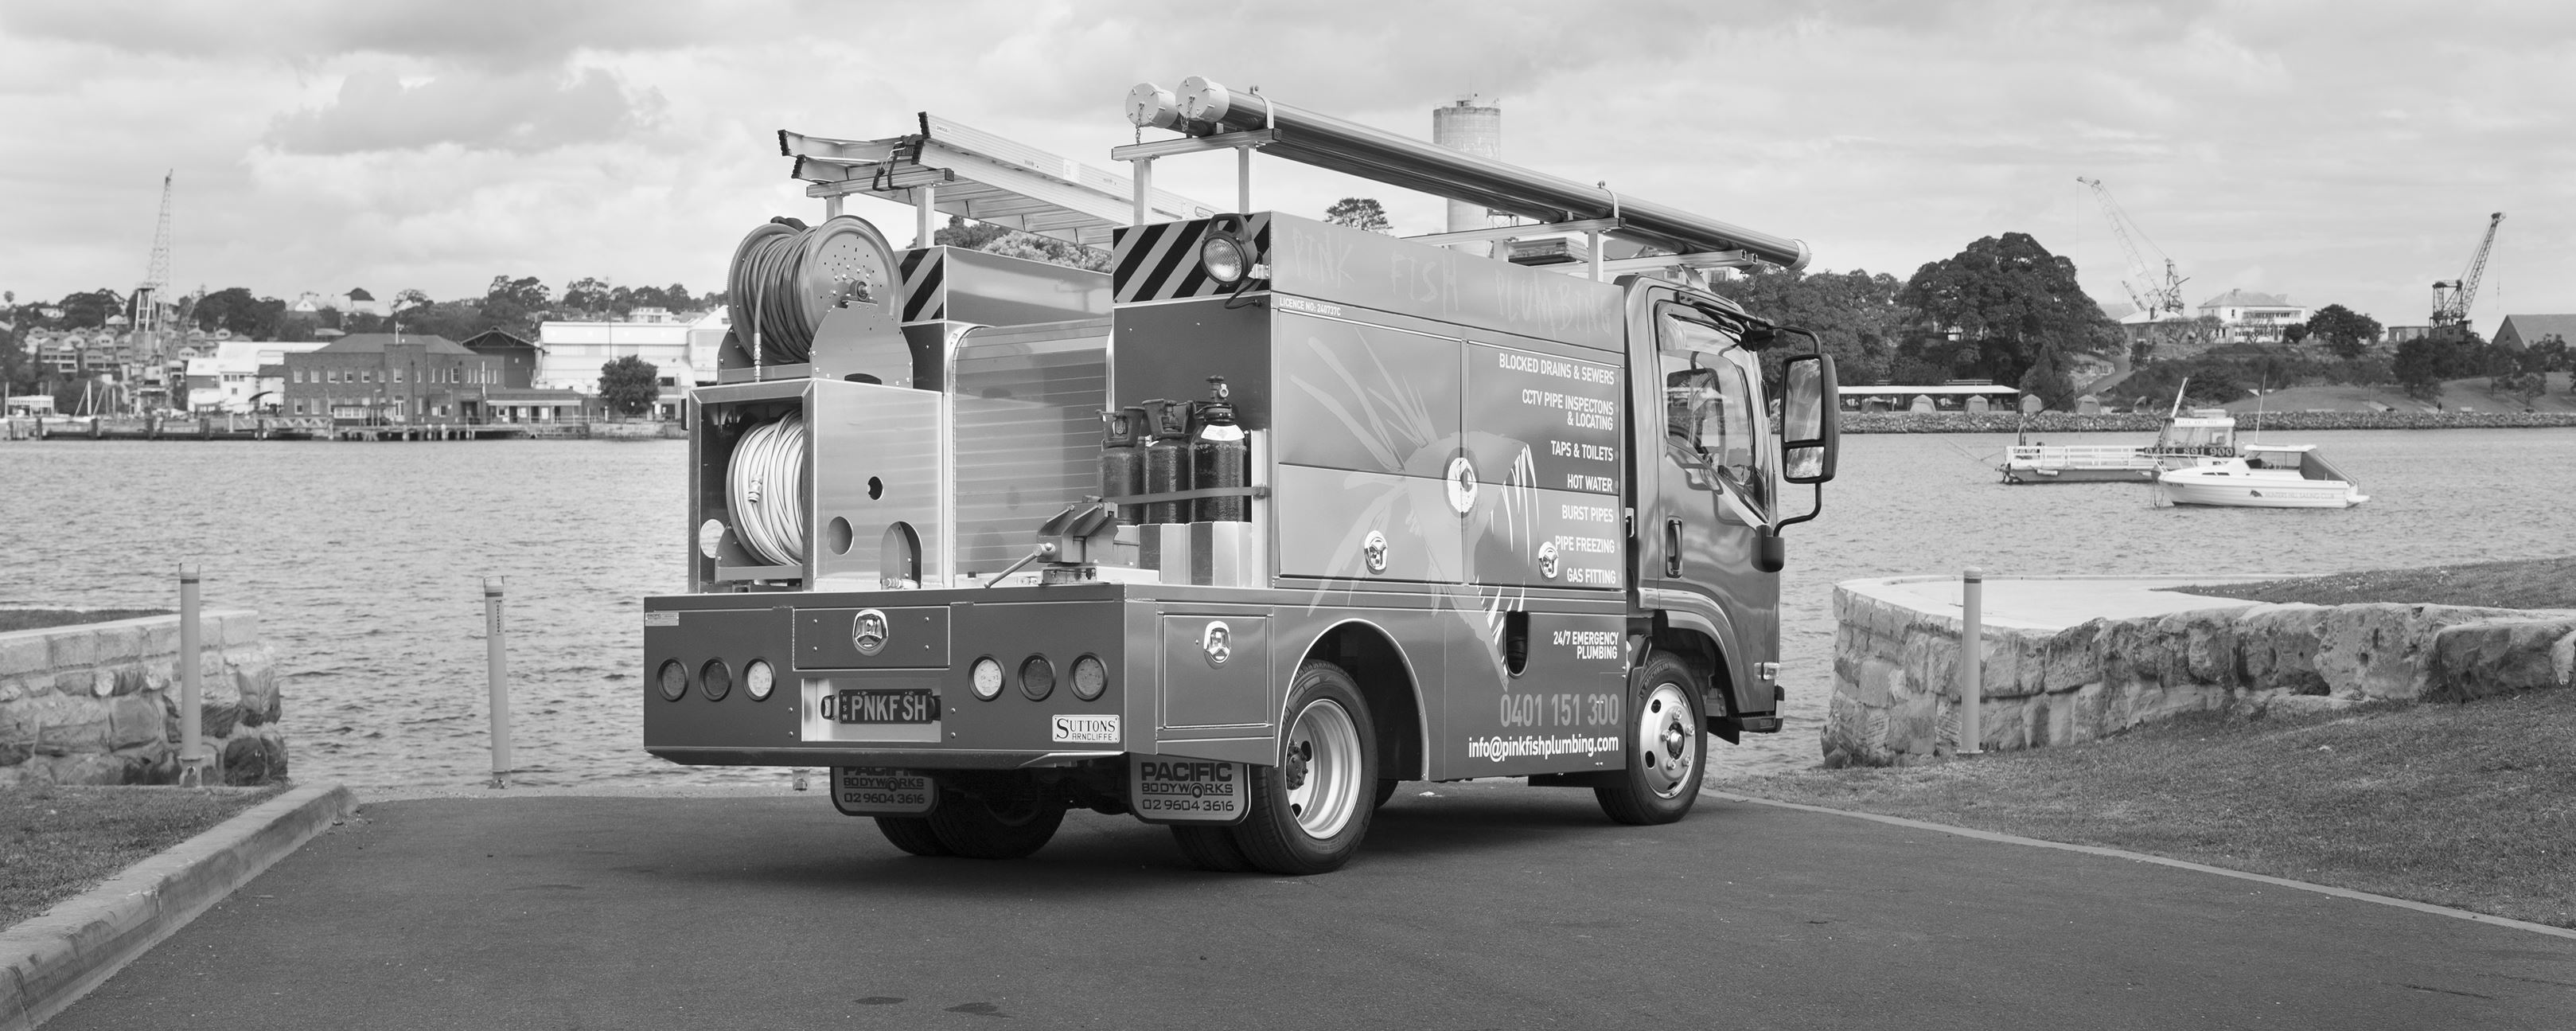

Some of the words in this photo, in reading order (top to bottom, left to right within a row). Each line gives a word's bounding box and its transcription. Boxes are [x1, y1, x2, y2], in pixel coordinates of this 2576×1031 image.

[1292, 226, 1355, 289] PINK
[1390, 250, 1459, 318] FISH
[1495, 268, 1611, 342] PLUMBING
[1280, 297, 1304, 310] LICENCE
[1305, 303, 1316, 312] NO:
[1499, 353, 1539, 373] BLOCKED
[1541, 360, 1572, 378] DRAINS
[1573, 365, 1580, 380] &
[1582, 367, 1615, 385] SEWERS
[1522, 389, 1542, 406] CCTV
[1544, 392, 1564, 408] PIPE
[1565, 395, 1614, 415] INSPECTONS
[1567, 411, 1573, 426] &
[1576, 412, 1613, 431] LOCATING
[1551, 440, 1572, 457] TAPS
[1573, 443, 1580, 458] &
[1582, 444, 1614, 462] TOILETS
[1567, 474, 1584, 489] HOT
[1585, 476, 1612, 492] WATER
[1562, 505, 1589, 521] BURST
[1591, 506, 1614, 522] PIPES
[1555, 535, 1574, 551] PIPE
[1576, 537, 1615, 553] FREEZING
[1567, 568, 1584, 583] GAS
[1585, 568, 1615, 584] FITTING
[1553, 630, 1572, 646] 24/7
[1572, 631, 1619, 646] EMERGENCY
[1576, 646, 1618, 660] PLUMBING
[852, 694, 926, 721] PNKFSH
[1500, 693, 1543, 728] 0401
[1551, 693, 1580, 726] 151
[1588, 693, 1619, 725] 300
[1072, 732, 1113, 741] ARNCLIFFE
[1469, 733, 1619, 762] info@pinkfishplumbing.com
[1140, 762, 1233, 782] PACIFIC
[844, 777, 924, 791] BODYWORKS
[1142, 783, 1233, 799] BODYWORKS
[844, 793, 861, 803] 02
[863, 793, 894, 803] 9604
[897, 794, 925, 804] 3616
[1143, 800, 1162, 810] 02
[1164, 800, 1200, 811] 9604
[1202, 801, 1234, 811] 3616
